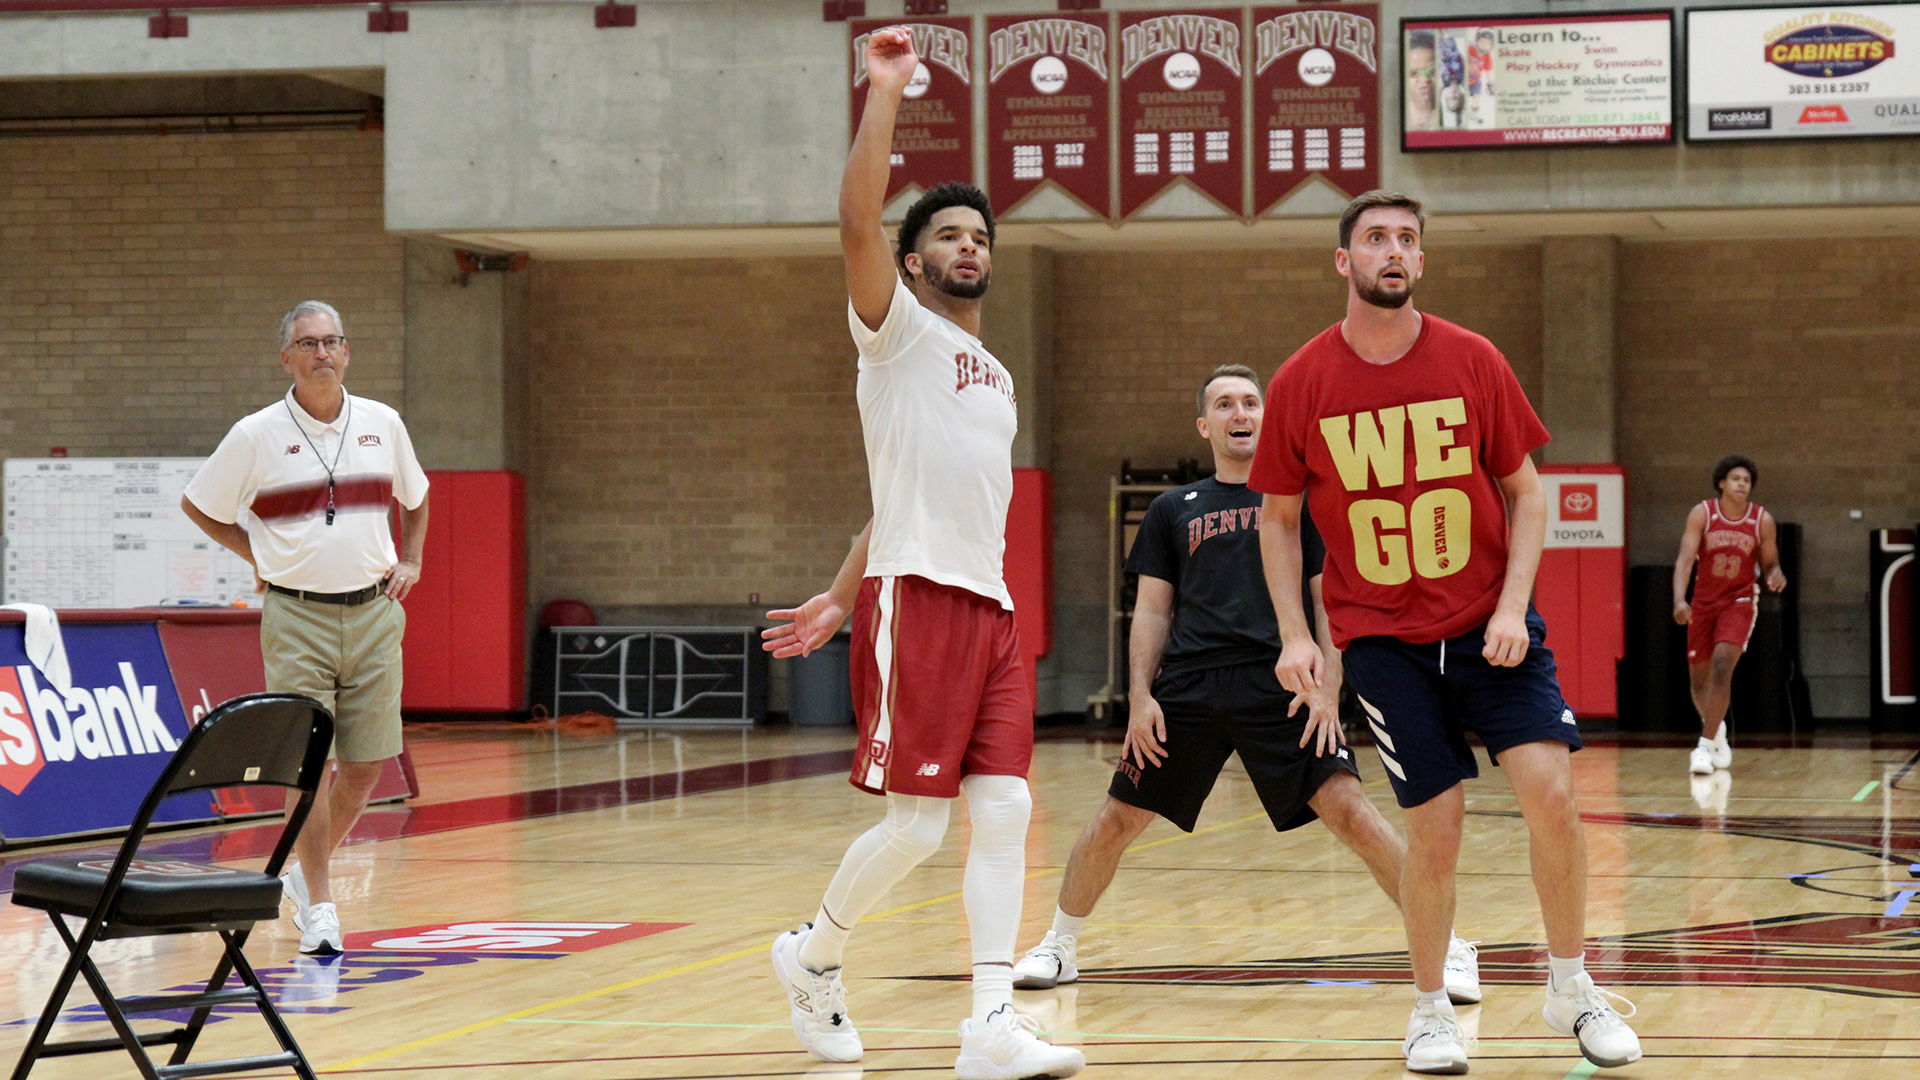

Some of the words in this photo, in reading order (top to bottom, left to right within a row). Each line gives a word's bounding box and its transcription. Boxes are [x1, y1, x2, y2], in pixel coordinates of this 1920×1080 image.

[1763, 11, 1824, 43] QUALITY
[1828, 11, 1896, 38] KITCHEN
[1498, 29, 1553, 44] Learn
[1122, 15, 1241, 79] DENVER
[1256, 10, 1377, 76] DENVER
[854, 23, 970, 88] DVER
[990, 19, 1108, 83] DENVER
[1498, 48, 1531, 58] Skate
[1584, 44, 1618, 55] Swim
[1771, 41, 1884, 63] CABINETS
[1304, 66, 1333, 75] NCAA
[1506, 61, 1531, 72] Play
[1536, 60, 1580, 71] Hockey
[1594, 57, 1663, 70] Gymnastics
[1036, 74, 1065, 82] NCAA
[1169, 70, 1198, 79] NCAA
[1528, 78, 1541, 88] at
[1546, 76, 1568, 86] the
[1573, 75, 1618, 86] Ritchie
[1623, 73, 1667, 85] Center
[1273, 87, 1360, 100] GYMNASTICS
[1789, 82, 1870, 94] 303.918.2357
[1007, 96, 1092, 108] GYMNASTICS
[1138, 90, 1225, 103] GYMNASTICS
[1145, 105, 1219, 117] REGIONALS
[1279, 102, 1354, 114] REGIONALS
[897, 111, 955, 123] KETBALL
[1012, 114, 1087, 126] NATIONALS
[1134, 117, 1229, 129] APPEARANCES
[1269, 113, 1364, 126] APPEARANCES
[1508, 115, 1532, 126] CALL
[1536, 114, 1572, 125] TODAY
[1713, 112, 1767, 123] KraftMaid
[1003, 128, 1096, 140] APPEARANCES
[1169, 132, 1194, 141] 2013
[1205, 131, 1229, 140] 2017
[1305, 129, 1328, 138] 2001
[892, 139, 959, 150] EARANCES
[1013, 146, 1042, 156] 2001
[1054, 143, 1085, 154] 2017
[1169, 142, 1195, 151] 2014
[1013, 156, 1043, 167] 2007
[1134, 153, 1158, 162] 2011
[1134, 163, 1159, 173] 2012
[357, 434, 382, 446] DENVER
[1319, 397, 1473, 491] WE
[1348, 488, 1472, 586] GO
[1433, 506, 1448, 556] DENVER
[1553, 530, 1604, 541] TOYOTA
[1703, 529, 1756, 557] DENVER
[1712, 553, 1741, 578] 23
